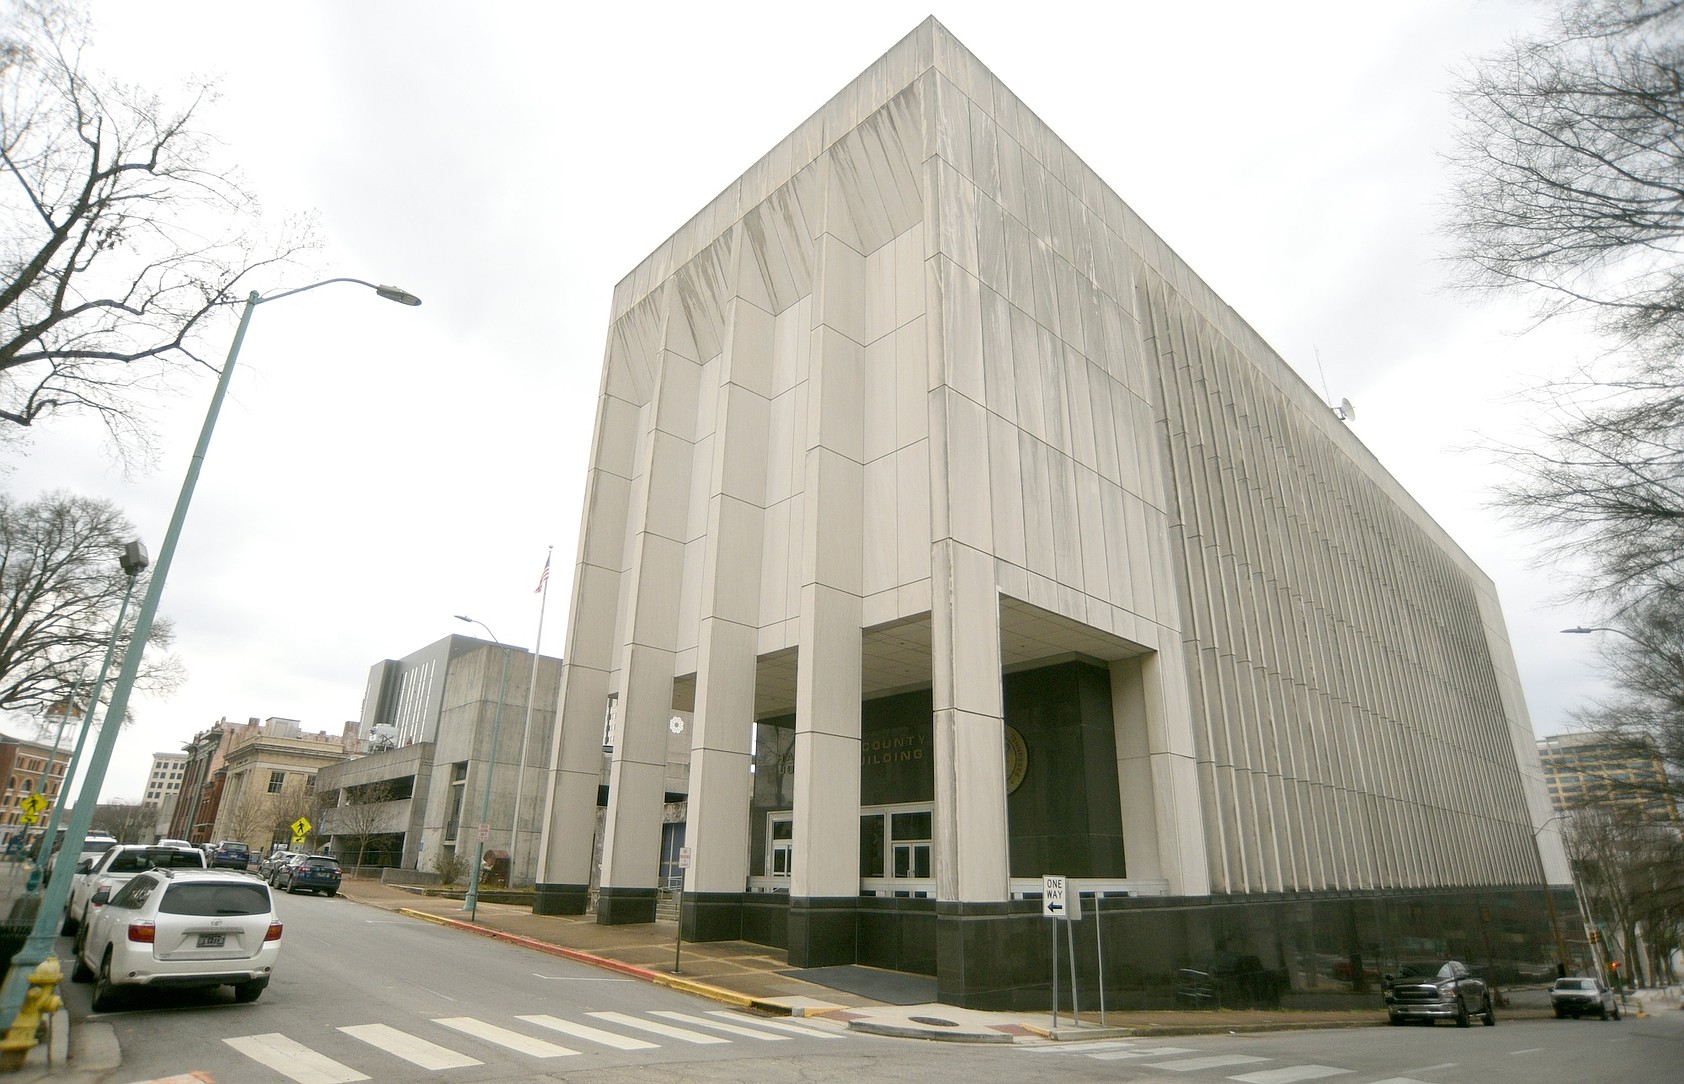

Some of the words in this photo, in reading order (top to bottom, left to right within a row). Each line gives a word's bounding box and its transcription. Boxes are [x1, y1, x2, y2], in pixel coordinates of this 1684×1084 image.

[862, 735, 926, 752] COUNTY
[1047, 879, 1062, 888] ONE
[1047, 890, 1062, 899] WAY
